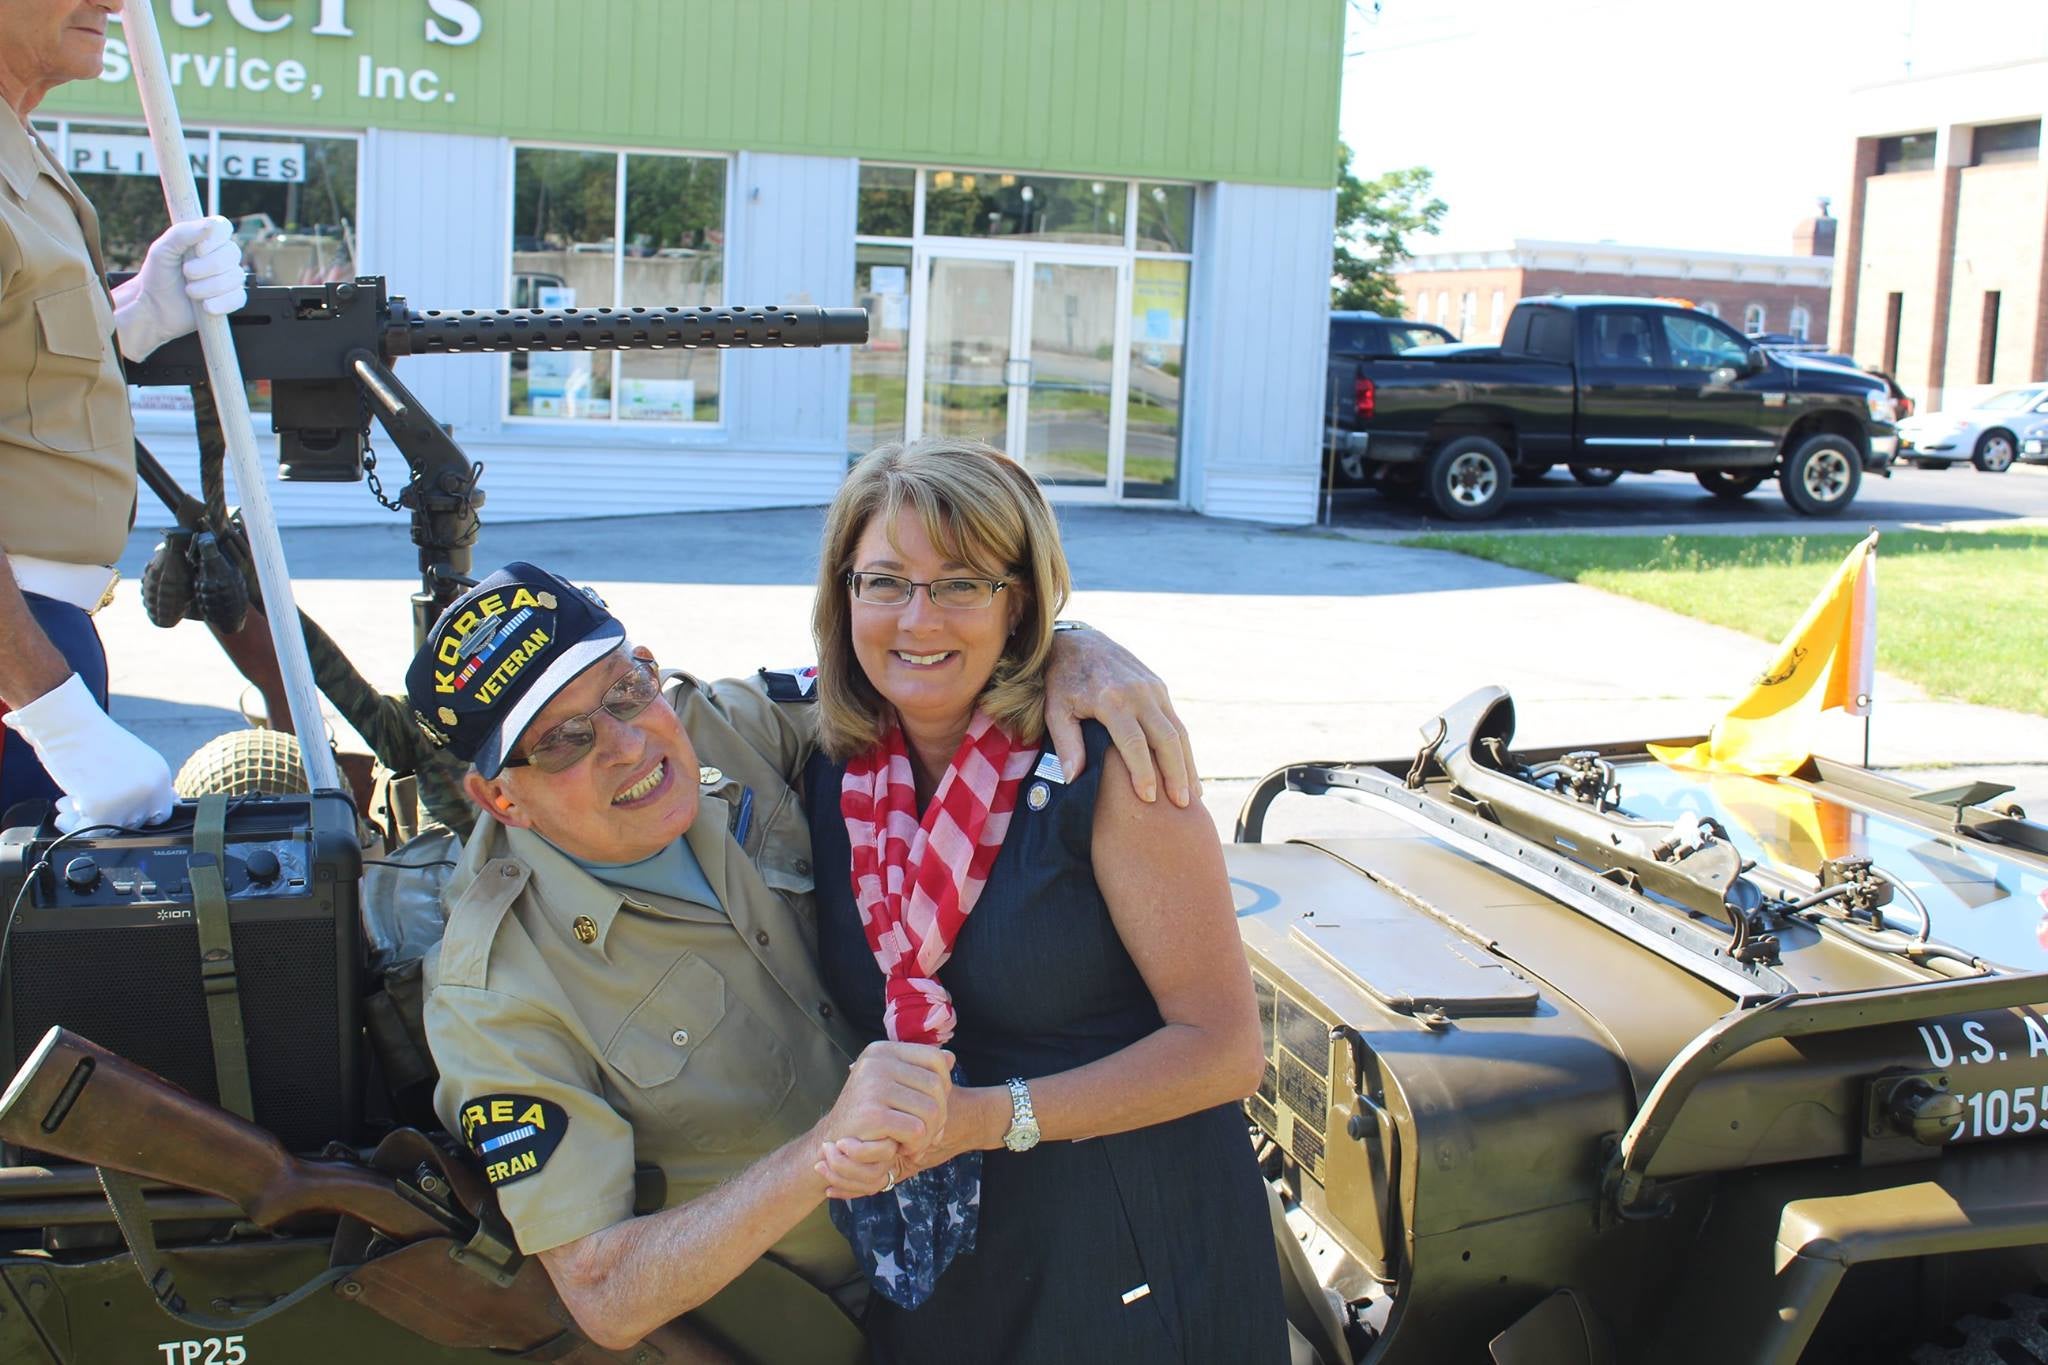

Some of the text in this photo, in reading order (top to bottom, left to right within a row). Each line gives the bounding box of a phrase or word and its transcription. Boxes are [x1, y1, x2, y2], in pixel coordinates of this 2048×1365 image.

[100, 38, 456, 102] Srvice, Inc.
[50, 148, 299, 179] PLINCES
[434, 587, 540, 693] KOREA
[474, 628, 550, 705] VETERAN
[1918, 1014, 2048, 1068] U.S. A
[462, 1100, 546, 1148] OREA
[158, 1335, 247, 1365] TP25
